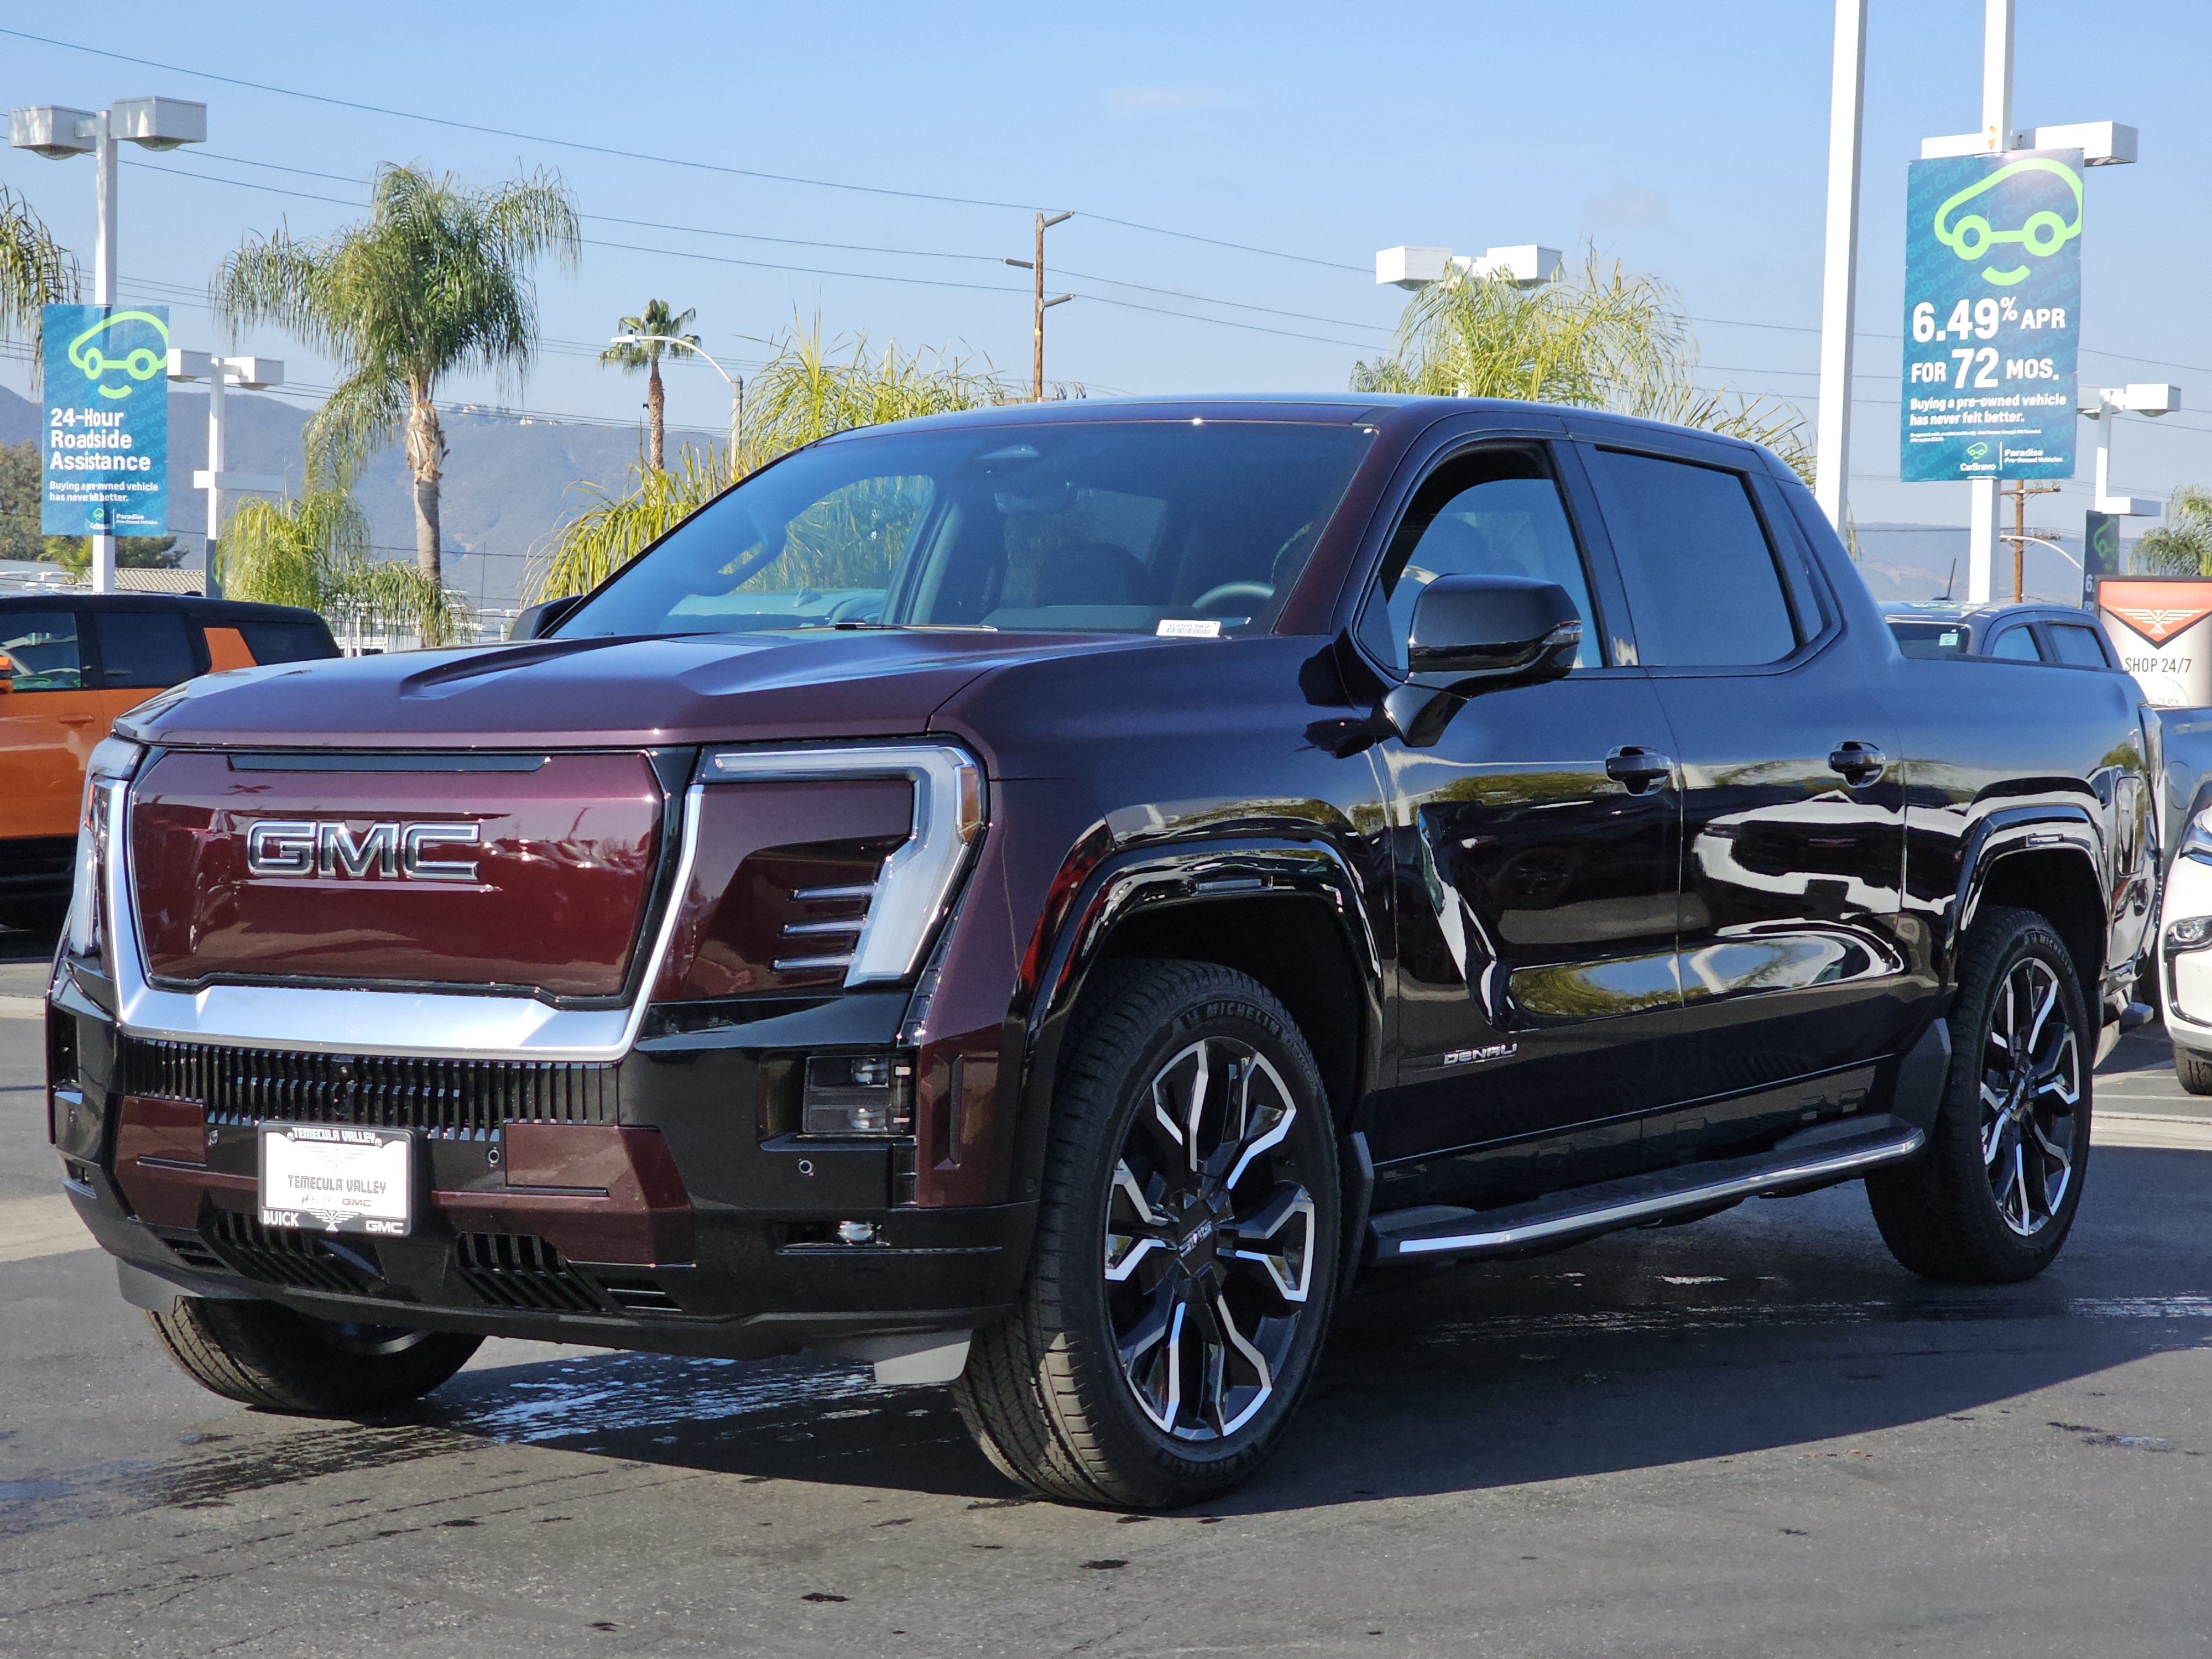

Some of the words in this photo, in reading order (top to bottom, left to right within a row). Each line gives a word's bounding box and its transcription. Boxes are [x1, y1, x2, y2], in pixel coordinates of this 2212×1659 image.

[1913, 297, 2018, 342] 6.49%
[2020, 308, 2066, 329] APR
[1911, 362, 1947, 383] FOR
[1952, 347, 1999, 389] 72
[2006, 358, 2059, 380] MOS.
[1910, 397, 1946, 412] Buying
[1948, 399, 1955, 408] a
[1956, 394, 2020, 411] pre-owned
[2022, 393, 2067, 406] vehicle
[50, 408, 124, 427] 24-Hour
[1910, 414, 1929, 426] has
[1930, 414, 1960, 425] never
[1963, 411, 1983, 424] felt
[1984, 411, 2025, 424] better.
[51, 429, 132, 448] Roadside
[50, 451, 151, 471] Assistance
[2004, 448, 2043, 457] Paradise
[1959, 462, 1996, 471] CarBravo
[49, 481, 79, 492] Buying
[127, 482, 159, 491] vehicle
[49, 492, 65, 501] has
[100, 493, 129, 502] better.
[2125, 658, 2158, 672] SHOP
[2162, 658, 2192, 674] 24/7
[247, 820, 481, 881] GMC
[1206, 1001, 1280, 1036] MICHELIN
[1443, 1042, 1518, 1065] DENALI
[292, 1127, 340, 1141] TEMECULA
[341, 1130, 375, 1144] VALLEY
[288, 1175, 343, 1191] TEMECULA
[346, 1179, 386, 1194] VALLEY
[343, 1198, 372, 1207] GMC
[263, 1210, 300, 1227] BUICK
[366, 1220, 404, 1234] GMC
